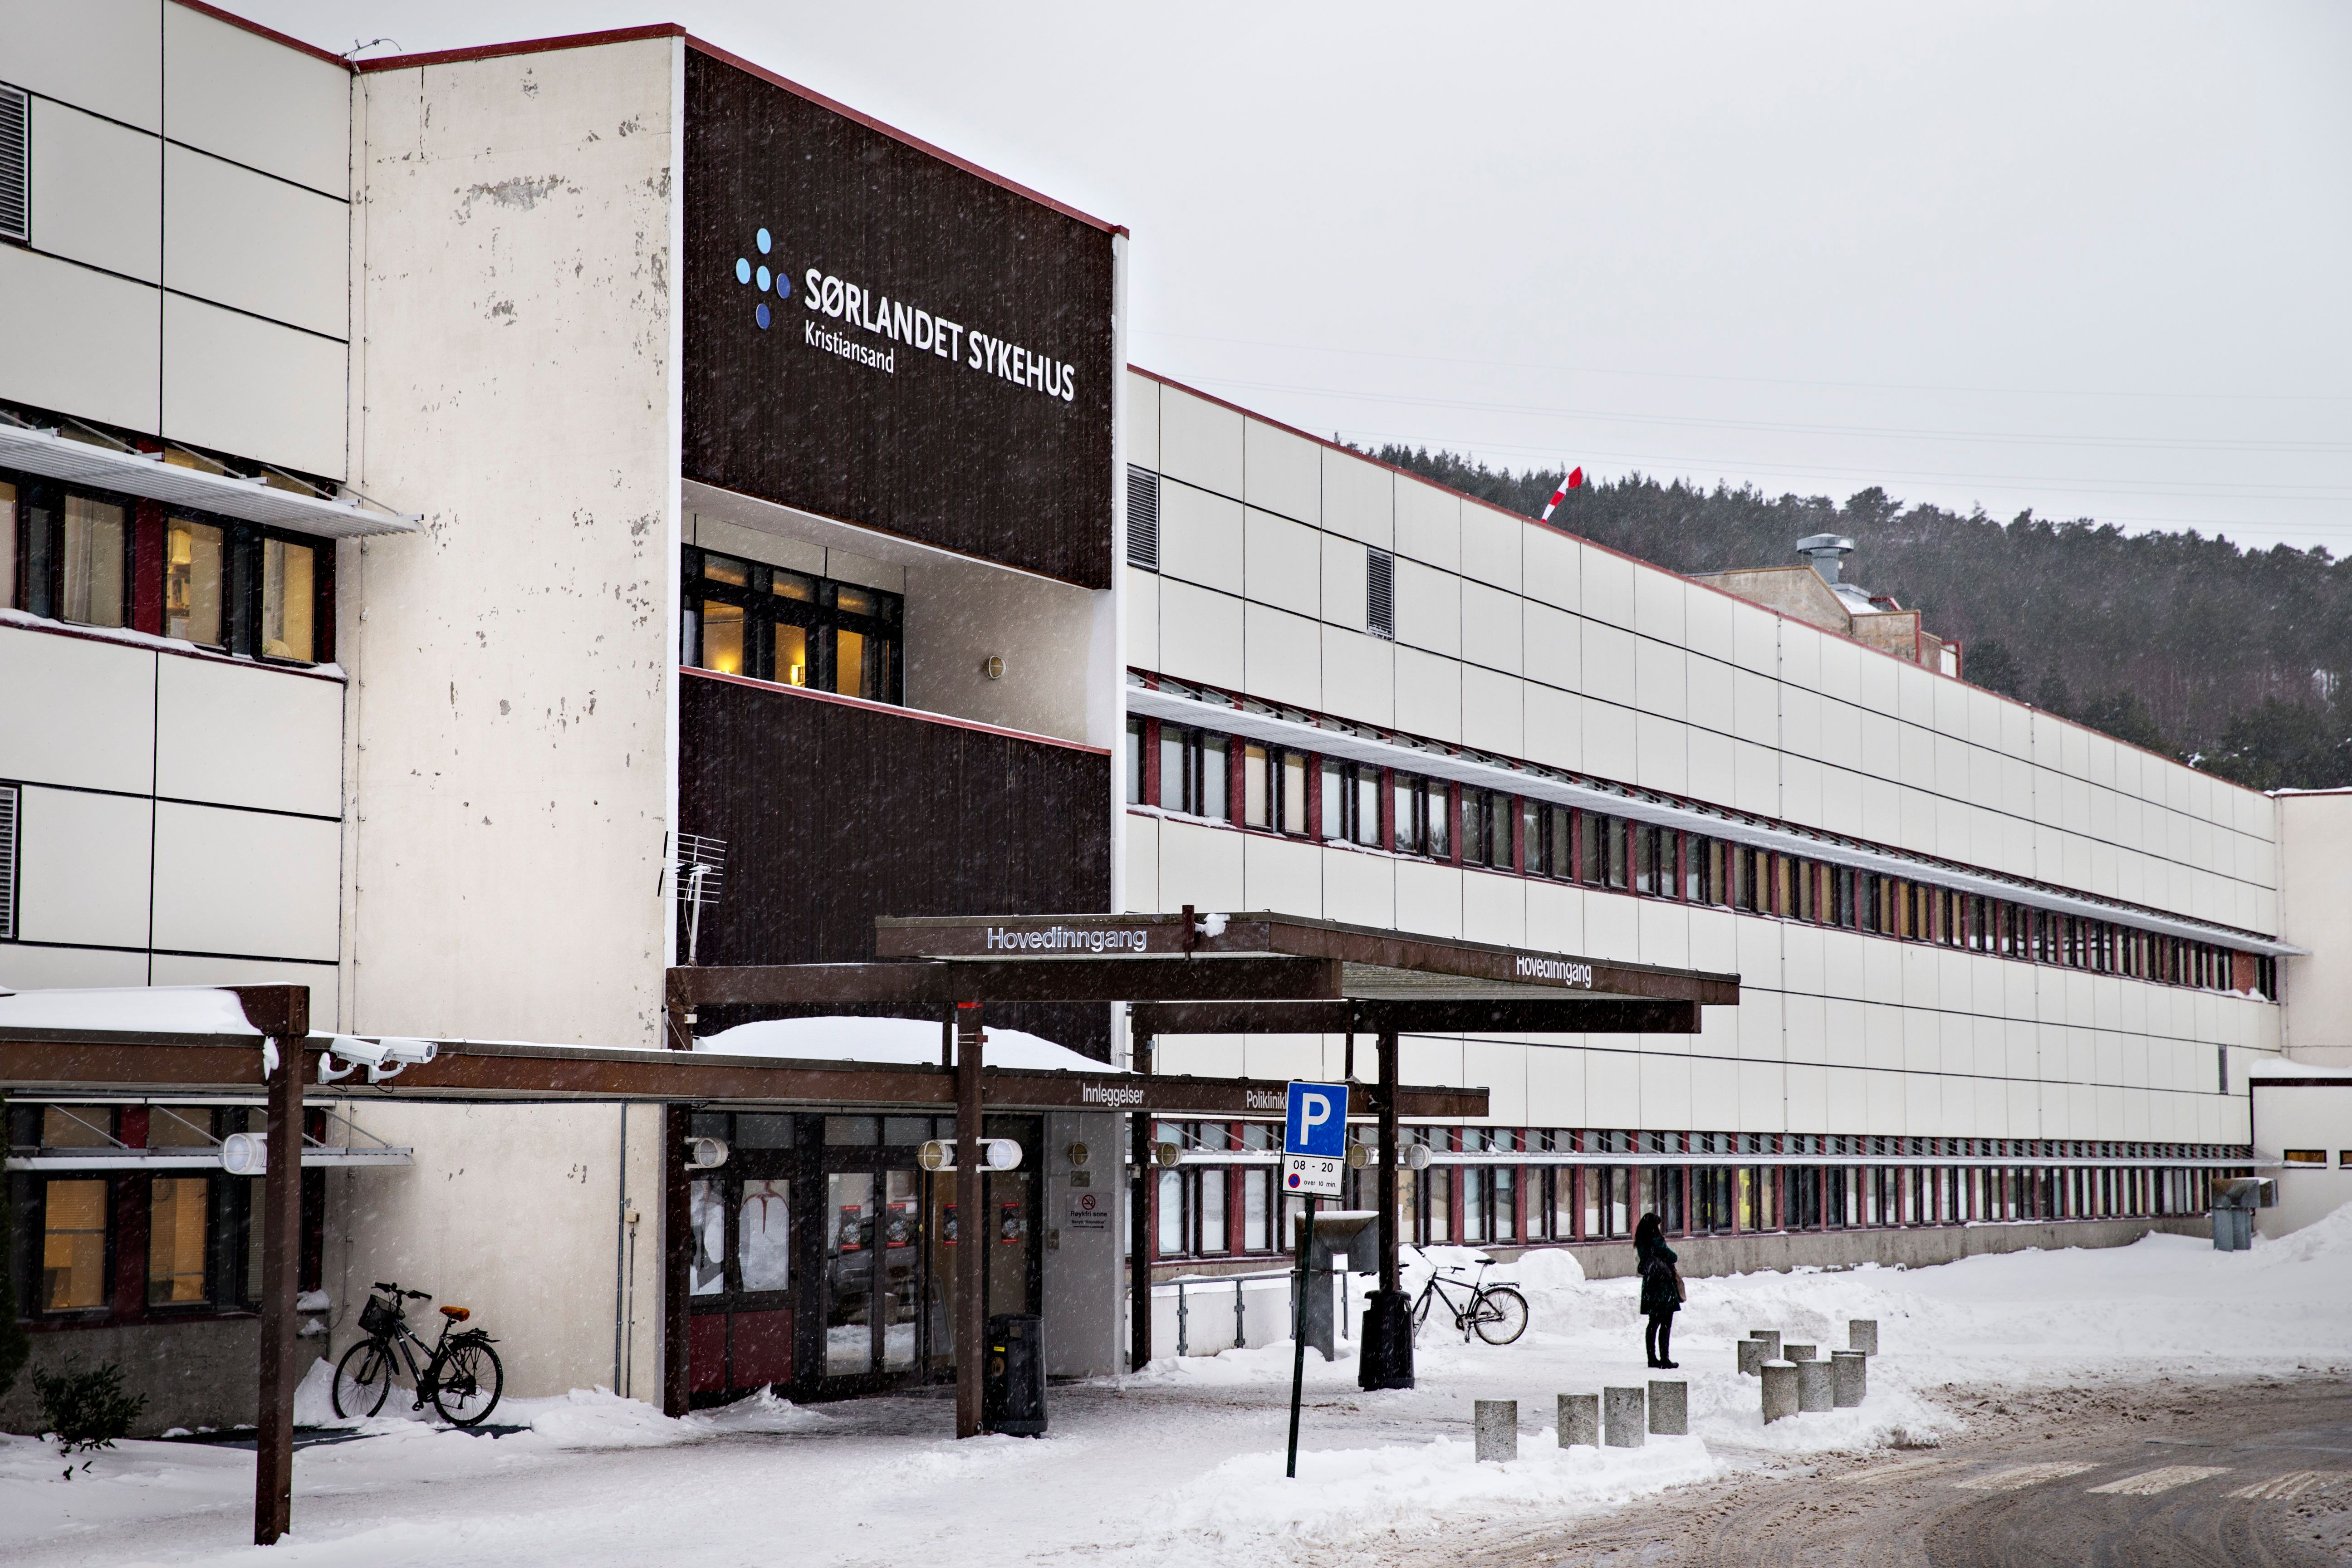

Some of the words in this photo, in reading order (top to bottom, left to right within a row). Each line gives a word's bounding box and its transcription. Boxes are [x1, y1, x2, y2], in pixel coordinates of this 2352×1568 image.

[804, 268, 963, 361] SØRLANDET
[968, 330, 1075, 401] SYKEHUS
[805, 319, 894, 373] Kristiansand
[987, 926, 1147, 952] Hovedinngang
[1516, 956, 1592, 989] Hovedinngang
[1083, 1083, 1144, 1107] Innleggelser
[1300, 1093, 1331, 1145] P
[1294, 1160, 1306, 1170] 08
[1321, 1162, 1333, 1173] 20
